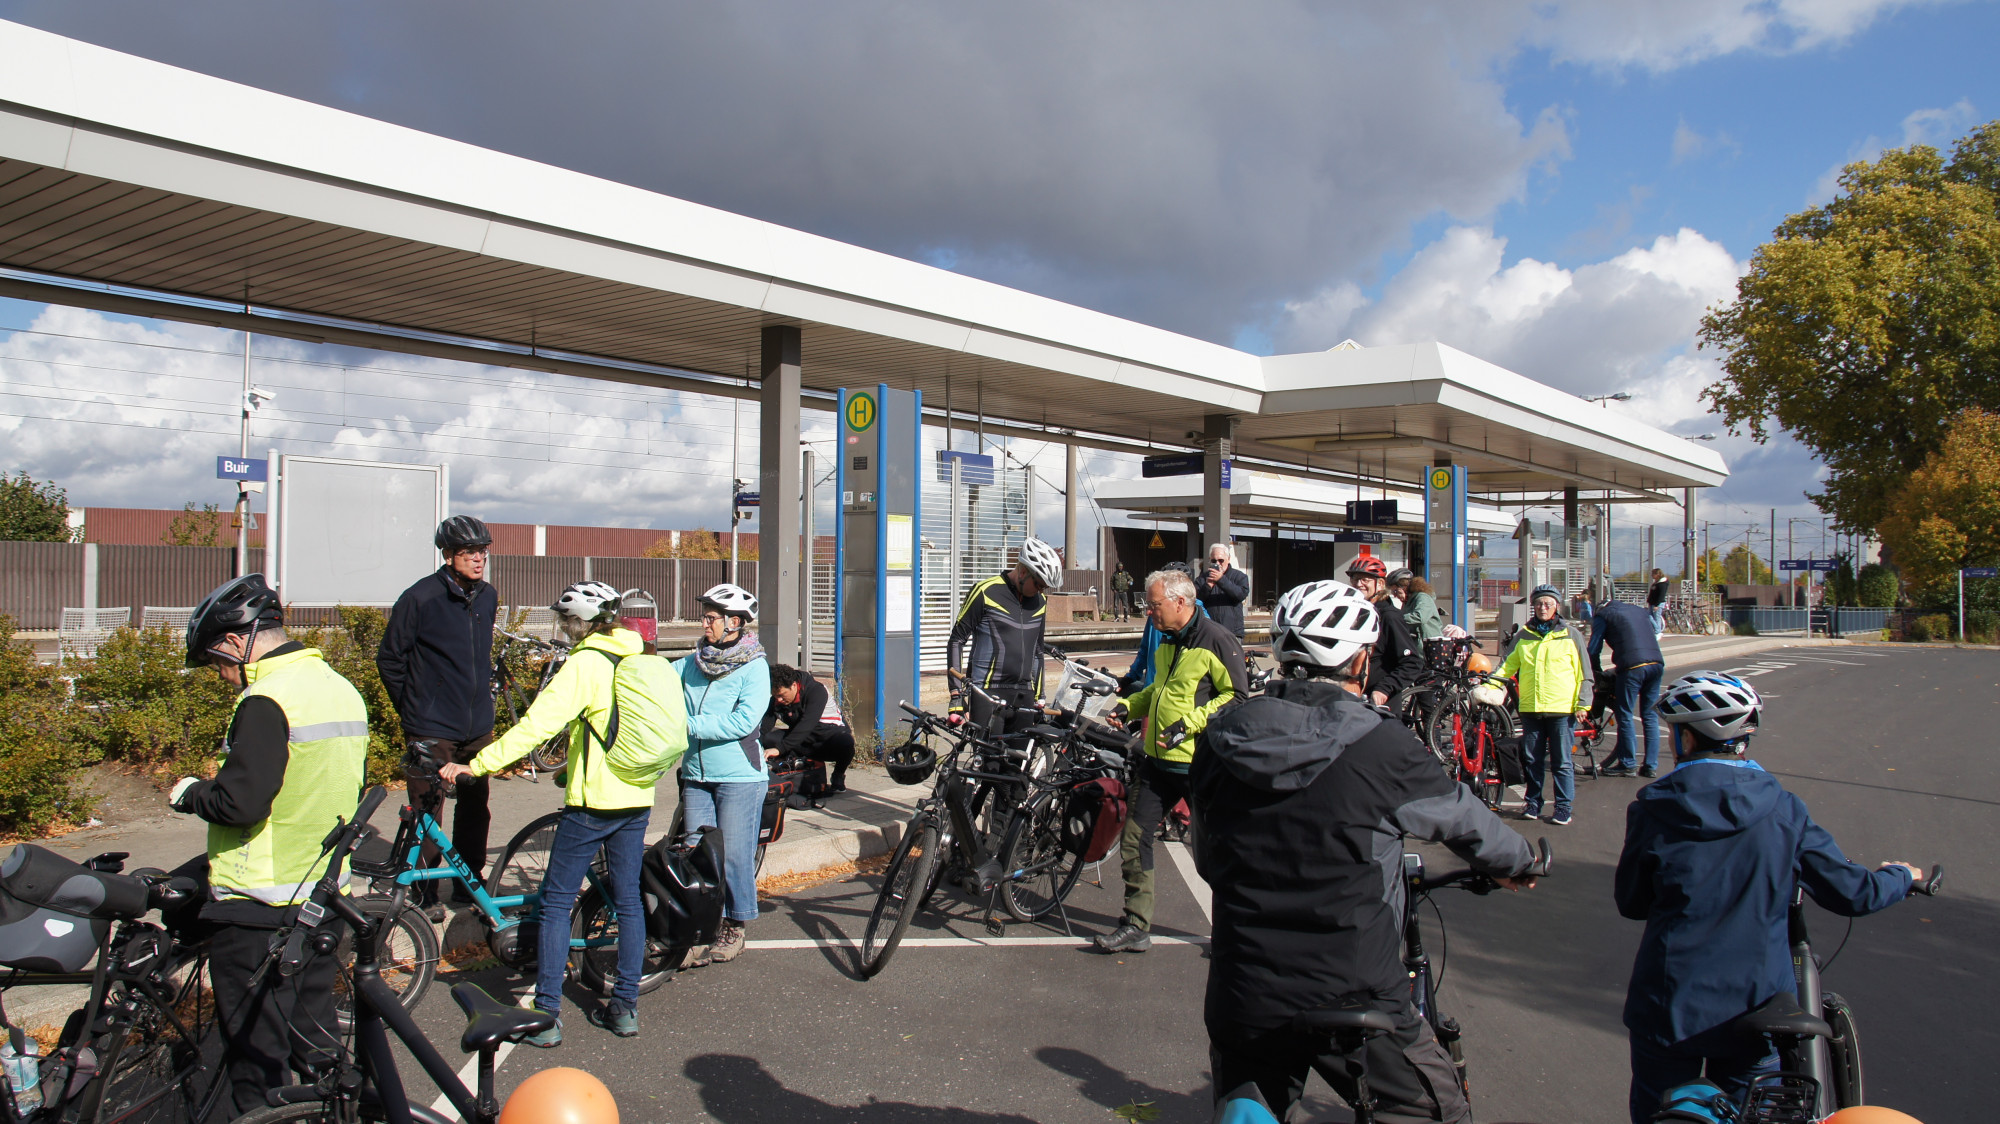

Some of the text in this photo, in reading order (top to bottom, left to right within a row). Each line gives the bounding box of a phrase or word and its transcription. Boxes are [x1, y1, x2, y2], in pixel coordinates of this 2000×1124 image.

[854, 400, 867, 424] H
[224, 460, 250, 474] Buir
[1436, 473, 1445, 486] H
[1348, 501, 1358, 521] 1
